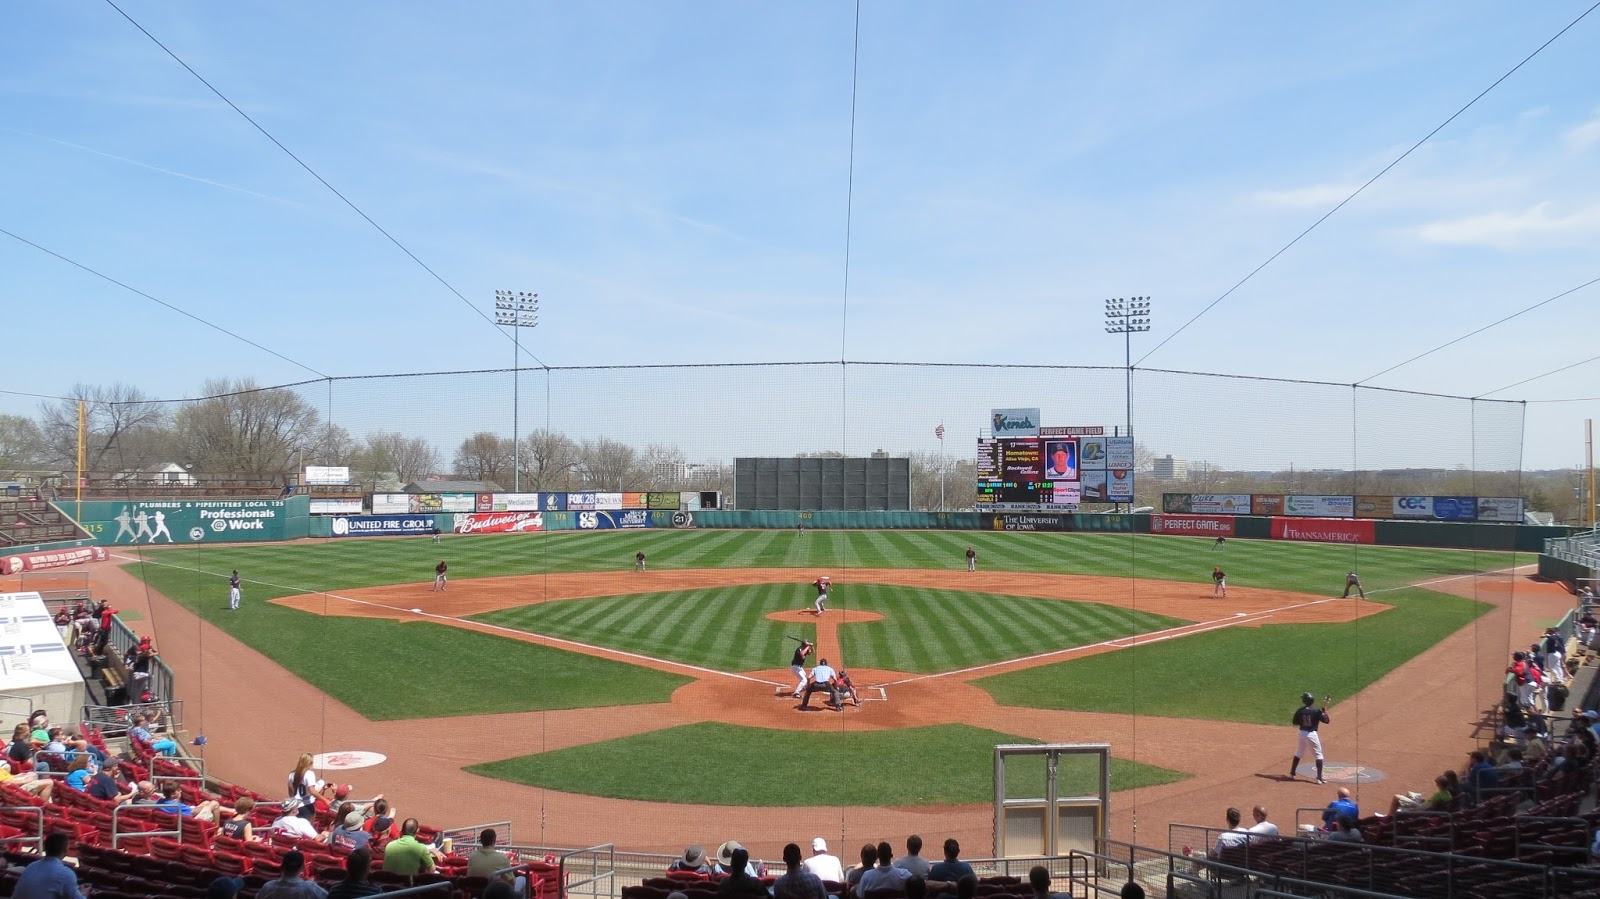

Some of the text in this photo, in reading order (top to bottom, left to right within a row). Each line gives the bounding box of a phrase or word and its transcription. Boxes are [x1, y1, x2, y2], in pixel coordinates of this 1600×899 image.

[568, 494, 594, 504] FOX 28
[200, 509, 275, 519] Professionals
[229, 519, 264, 530] Work
[349, 520, 434, 529] UNITED FIRE GROUP
[460, 512, 531, 533] Budweiser
[1020, 516, 1058, 524] UNIVERSITY
[1165, 520, 1195, 529] PERFECT
[1289, 529, 1358, 541] TRANSAMERICA
